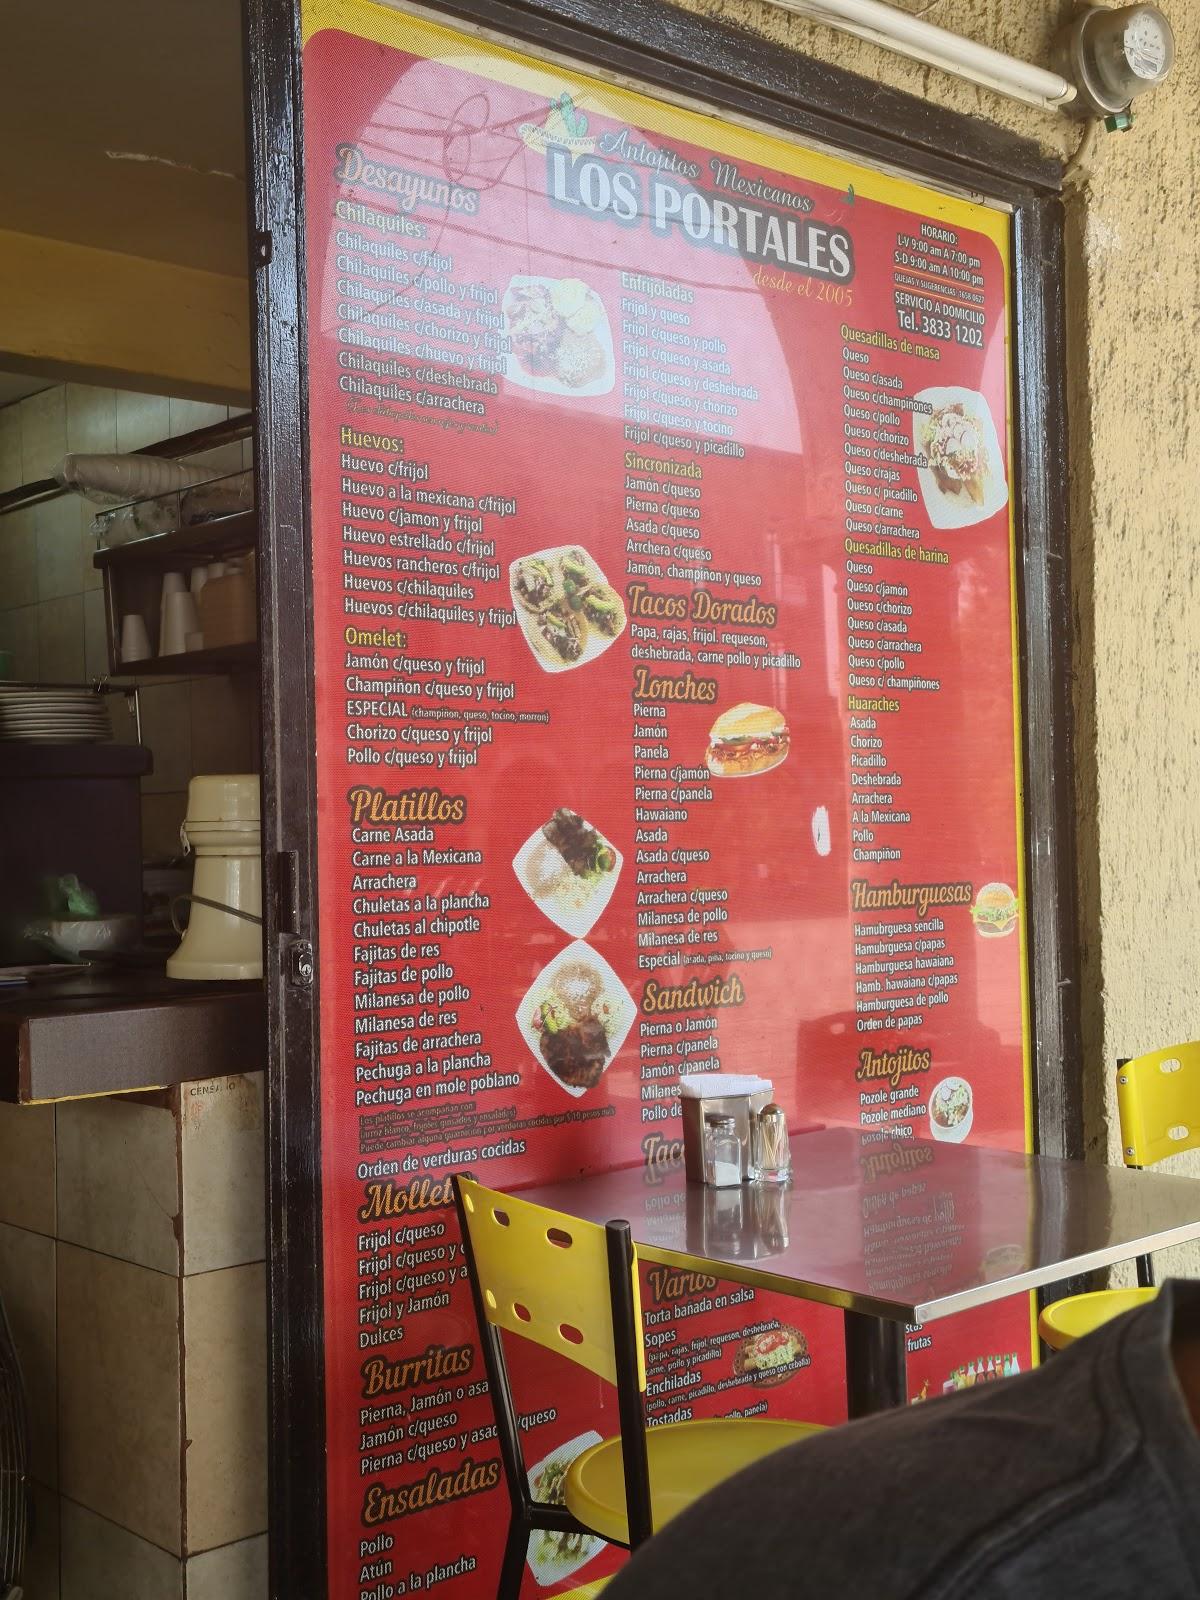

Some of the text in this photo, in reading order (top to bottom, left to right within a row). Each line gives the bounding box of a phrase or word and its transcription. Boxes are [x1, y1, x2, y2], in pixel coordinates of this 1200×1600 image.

[338, 149, 478, 212] Desayunos
[601, 131, 811, 212] Antojitos Mexicanos
[336, 201, 425, 237] Chilaquiles:
[554, 152, 850, 277] LOS PORTALES
[921, 224, 958, 244] HORARIO:
[337, 232, 452, 273] Chilaquiles c/frijol
[898, 236, 980, 268] L-V 9:00 am A 7:00 pm
[895, 252, 983, 286] S-D 9:00 am A 10:00 pm
[622, 273, 693, 303] Enfrijoladas
[753, 266, 852, 306] desde el 2005
[623, 300, 689, 325] Frijol y queso
[895, 292, 984, 325] SERVICIO A DOMICILIO
[898, 310, 982, 346] Tel. 3833 1202
[841, 325, 939, 360] Quesadillas de masa
[843, 347, 869, 363] Queso
[339, 352, 497, 394] Chilaquiles c/deshebrada
[339, 376, 485, 414] Chilaquiles c/arrachera
[341, 428, 403, 451] Huevos:
[625, 425, 744, 458] Frijol c/queso y picadillo
[845, 423, 909, 446] Queso c/chorizo
[342, 455, 428, 480] Huevo c/frijol
[625, 453, 701, 479] Sincronizada
[342, 479, 516, 515] Huevo a la mexicana c/frijol
[627, 539, 711, 560] Arrchera c/queso
[845, 538, 948, 563] Quesadillas de harina
[344, 550, 500, 580] Huevos rancheros c/frijol
[847, 579, 908, 597] Queso c/jamón
[629, 586, 775, 623] Tacos Dorados
[346, 627, 406, 648] Omelet:
[631, 625, 659, 640] Papa,
[663, 627, 689, 642] rajas,
[722, 634, 768, 647] requeson,
[346, 653, 484, 676] Jamón c/queso y frijol
[635, 669, 715, 700] Lonches
[348, 701, 408, 717] ESPECIAL
[634, 704, 665, 717] Pierna
[848, 696, 899, 711] Huaraches
[634, 725, 667, 738] Jamón
[850, 717, 876, 729] Asada
[635, 746, 668, 759] Panela
[851, 735, 882, 748] Chorizo
[852, 773, 901, 785] Deshebrada
[351, 789, 463, 821] Platillos
[636, 787, 712, 803] Pierna c/panela
[636, 808, 687, 820] Hawaiano
[352, 827, 434, 842] Carne Asada
[353, 849, 481, 865] Carne a la Mexicana
[353, 874, 416, 889] Arrachera
[853, 883, 971, 916] Hamburguesas
[354, 918, 479, 939] Chuletas al chipotle
[638, 908, 727, 926] Milanesa de pollo
[855, 919, 943, 937] Hamubrguesa sencilla
[643, 977, 743, 1011] Sandwich
[355, 1012, 457, 1033] Milanesa de res
[640, 1016, 717, 1036] Pierna o Jamón
[857, 1015, 922, 1031] Orden de papas
[858, 1049, 930, 1086] Antojitos
[356, 1073, 519, 1106] Pechuga en mole poblano
[861, 1085, 918, 1105] Pozole grande
[358, 1140, 525, 1179] Orden de verduras cocidas
[359, 1225, 444, 1252] Frijol c/queso
[645, 1289, 754, 1325] Torta bañada en salsa
[645, 1330, 676, 1347] Sopes
[907, 1336, 931, 1351] frutas
[365, 1349, 470, 1396] Burritas
[647, 1372, 701, 1396] Enchiladas
[360, 1414, 457, 1450] Jamón c/queso
[365, 1460, 498, 1522] Ensaladas
[361, 1534, 393, 1557] Pollo
[360, 1561, 392, 1582] Atún
